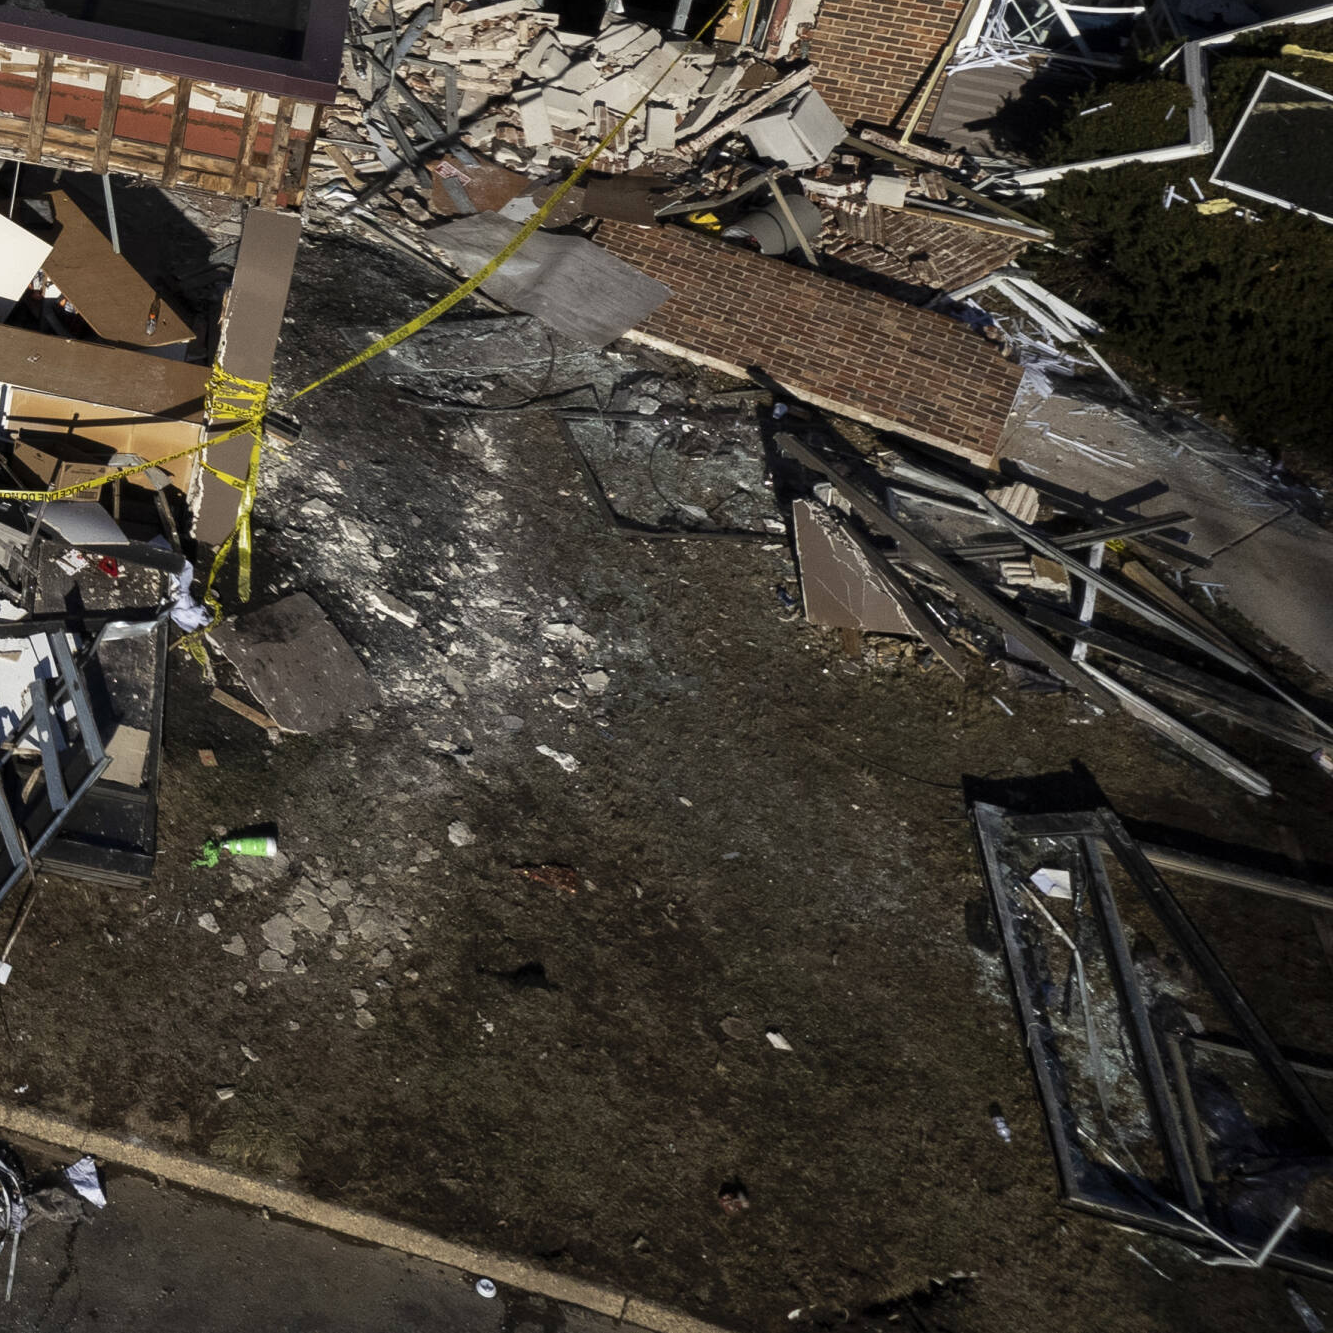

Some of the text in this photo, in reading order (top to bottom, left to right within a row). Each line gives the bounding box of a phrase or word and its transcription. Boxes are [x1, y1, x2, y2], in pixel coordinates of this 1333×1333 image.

[21, 491, 37, 501] DO
[39, 491, 59, 502] LINE
[61, 483, 91, 499] POLICE
